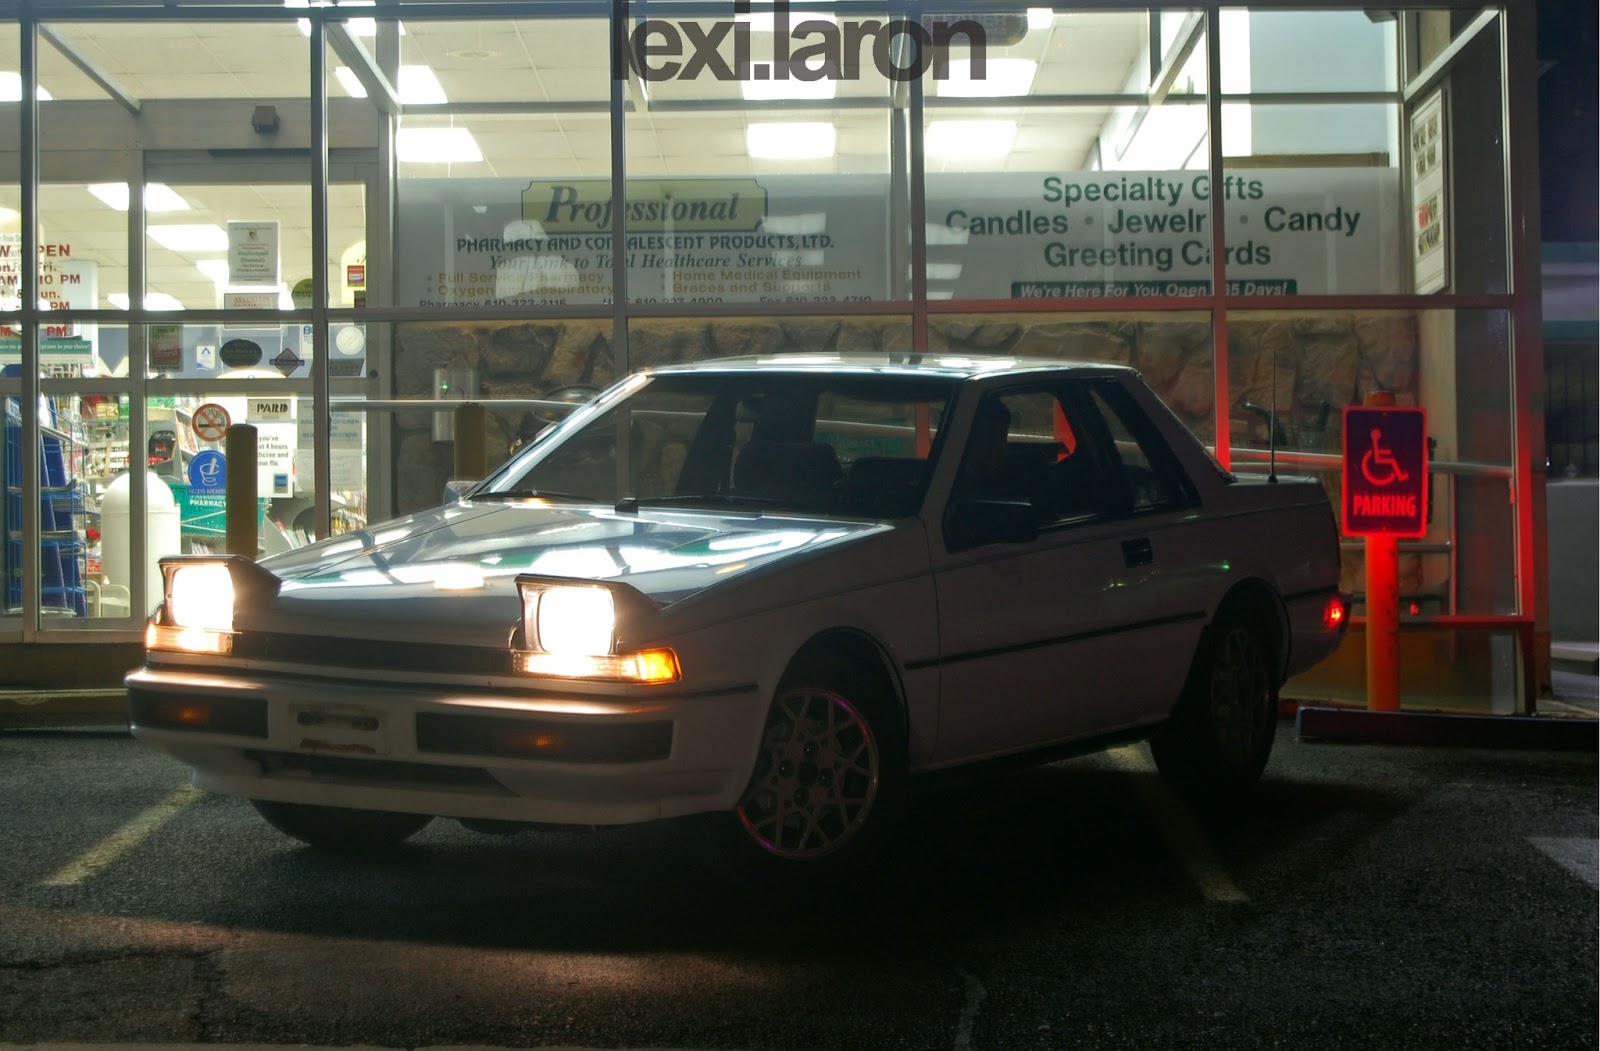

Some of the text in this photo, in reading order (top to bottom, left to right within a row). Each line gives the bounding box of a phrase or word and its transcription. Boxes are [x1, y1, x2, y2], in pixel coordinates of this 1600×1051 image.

[1043, 175, 1264, 207] Specialty Gfts
[945, 206, 1361, 237] Candles Jewelr Candy
[39, 244, 71, 257] PEN
[456, 237, 544, 252] PHARMACY
[547, 236, 582, 251] AND
[585, 236, 704, 251] COALESCENT
[489, 252, 802, 270] Your Link to Tol Healthcare Services
[1044, 240, 1173, 272] Greeting
[60, 274, 81, 284] PM
[438, 272, 604, 285] Full Service Pharmacy
[672, 268, 862, 283] Home Medical Equipment
[40, 291, 60, 299] un.
[438, 285, 494, 297] Oxygen
[530, 285, 615, 297] Respiratory
[672, 281, 832, 295] Braces and Supports
[1020, 284, 1062, 297] We're
[1065, 284, 1100, 297] Here
[1104, 284, 1129, 297] For
[1166, 284, 1207, 297] Open
[1244, 282, 1288, 296] Days!
[46, 326, 67, 336] PM
[190, 499, 227, 508] PHARMACY
[1353, 494, 1417, 517] PARKING
